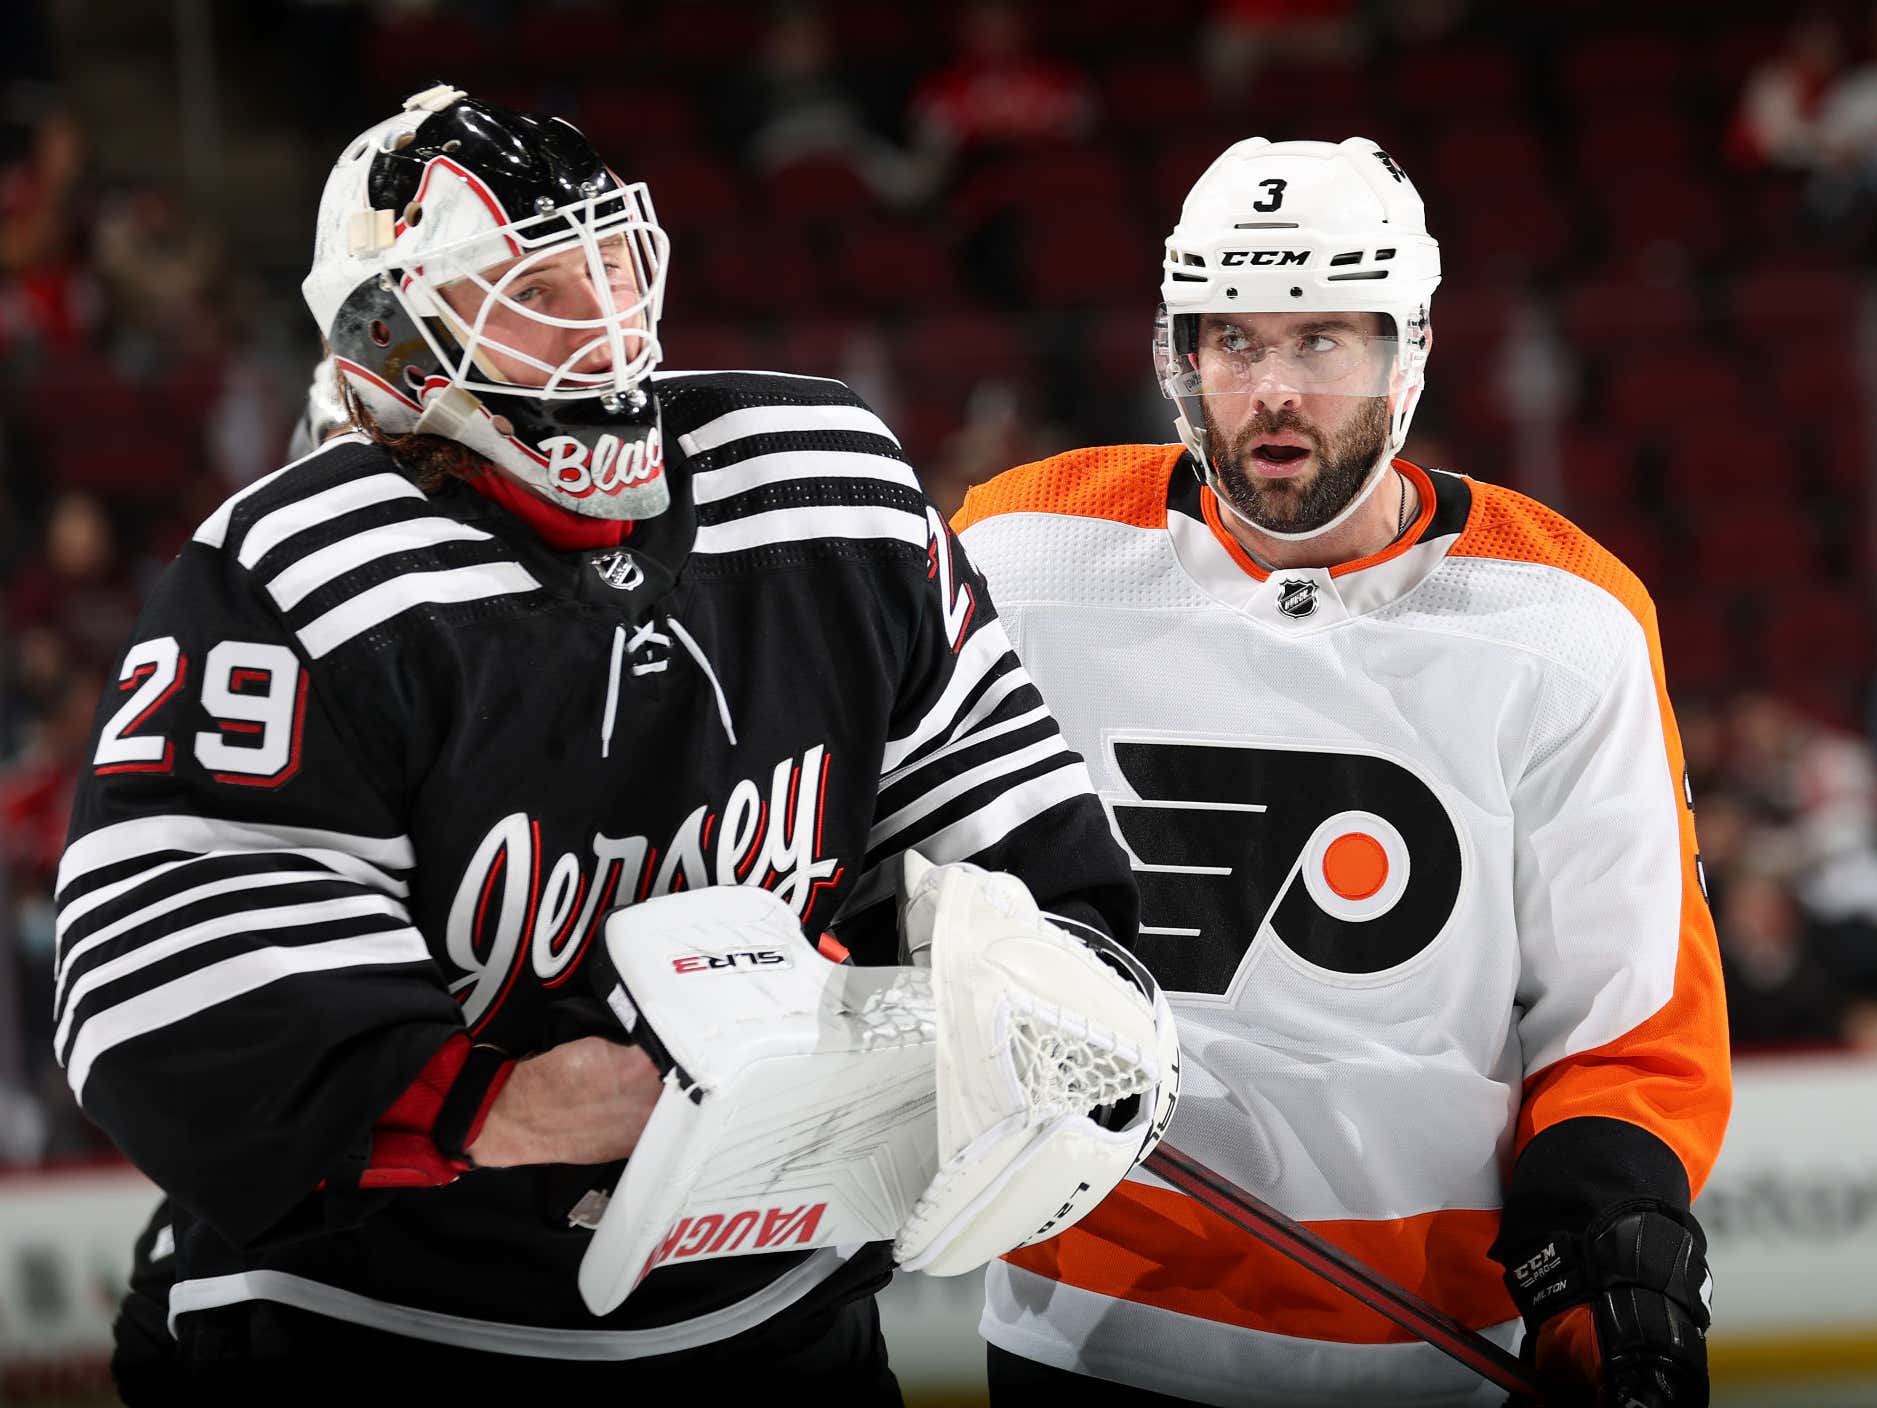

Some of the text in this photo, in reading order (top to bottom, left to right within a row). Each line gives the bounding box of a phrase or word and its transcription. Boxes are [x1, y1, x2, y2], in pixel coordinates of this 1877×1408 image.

[1253, 178, 1288, 213] 3
[1221, 251, 1312, 266] CCM
[93, 636, 310, 788] 29
[672, 951, 785, 974] SLR3
[1513, 1242, 1556, 1280] CCM
